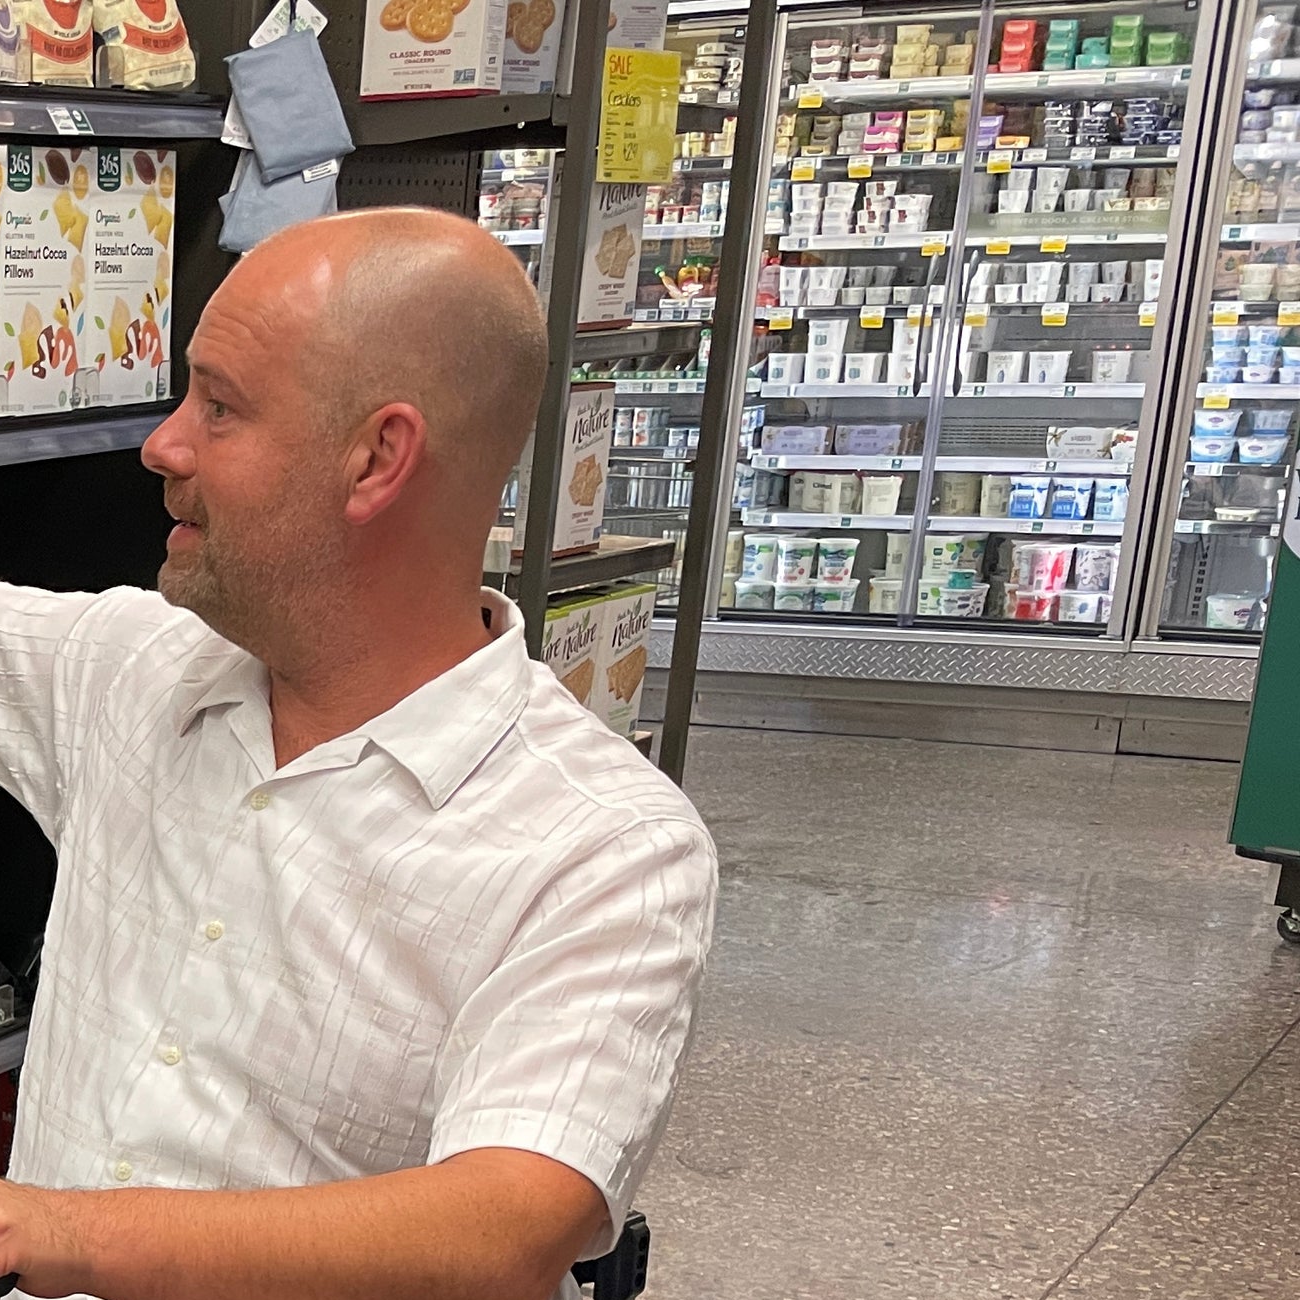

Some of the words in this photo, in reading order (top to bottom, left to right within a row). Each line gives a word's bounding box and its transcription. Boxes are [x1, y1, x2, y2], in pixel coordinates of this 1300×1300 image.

[390, 51, 421, 59] CLASSIC
[423, 49, 451, 57] ROUND
[610, 55, 632, 74] SALE
[608, 90, 641, 107] Crackers
[10, 152, 30, 176] 365
[100, 153, 119, 176] 365
[6, 211, 32, 231] Organic
[96, 210, 120, 226] Organic
[5, 246, 42, 260] Hazelnut
[43, 247, 67, 260] Cocoa
[95, 244, 130, 256] Hazelnut
[131, 244, 153, 257] Cocoa
[4, 265, 34, 278] Pillows
[95, 262, 122, 273] Pillows
[572, 408, 609, 444] nature
[612, 611, 649, 647] nature
[562, 624, 597, 660] nature
